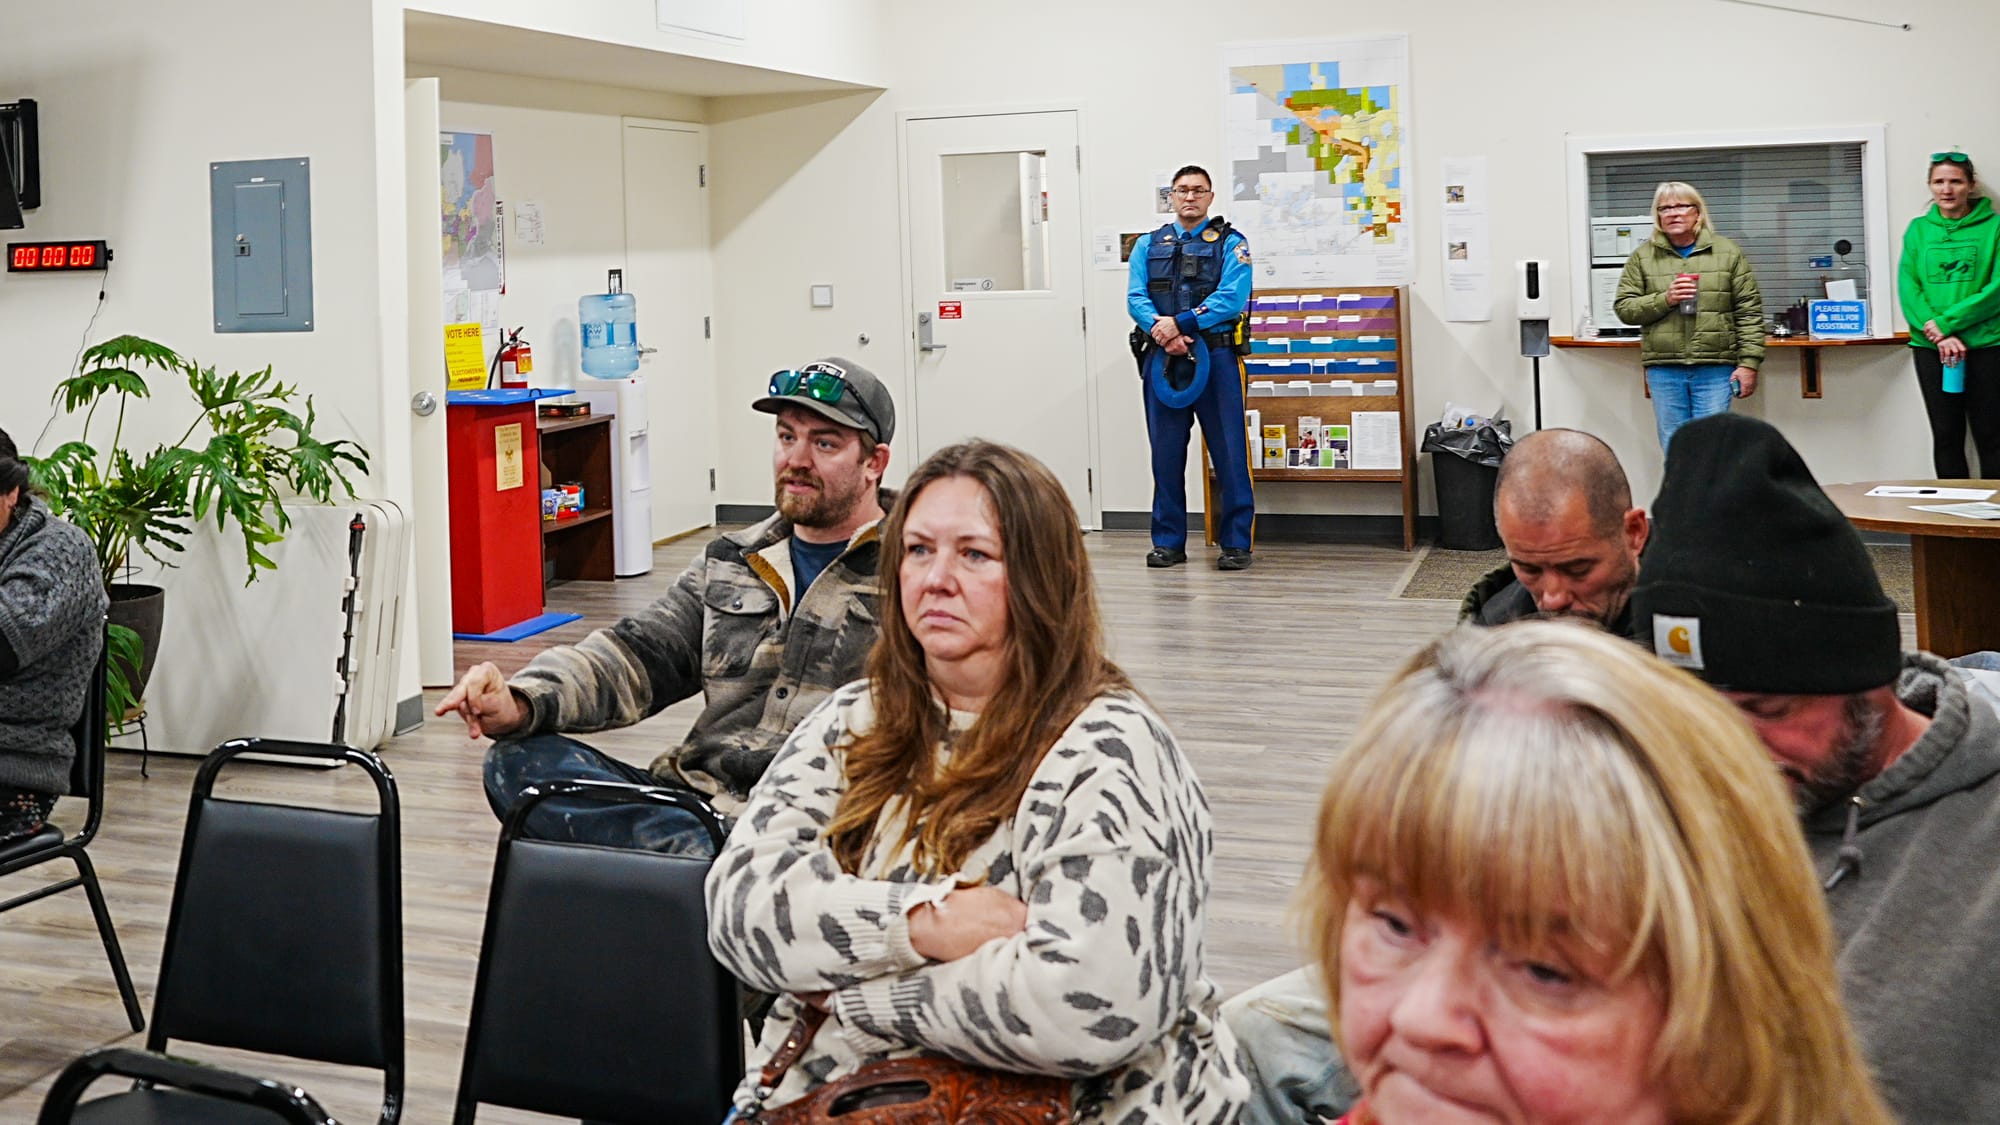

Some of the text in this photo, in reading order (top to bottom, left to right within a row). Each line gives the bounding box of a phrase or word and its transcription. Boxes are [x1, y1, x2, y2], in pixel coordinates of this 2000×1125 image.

[14, 246, 95, 267] 00 00 00
[1814, 305, 1841, 313] PLEASE
[1815, 322, 1860, 330] ASSISTANCE
[446, 327, 479, 339] VOTE HERE
